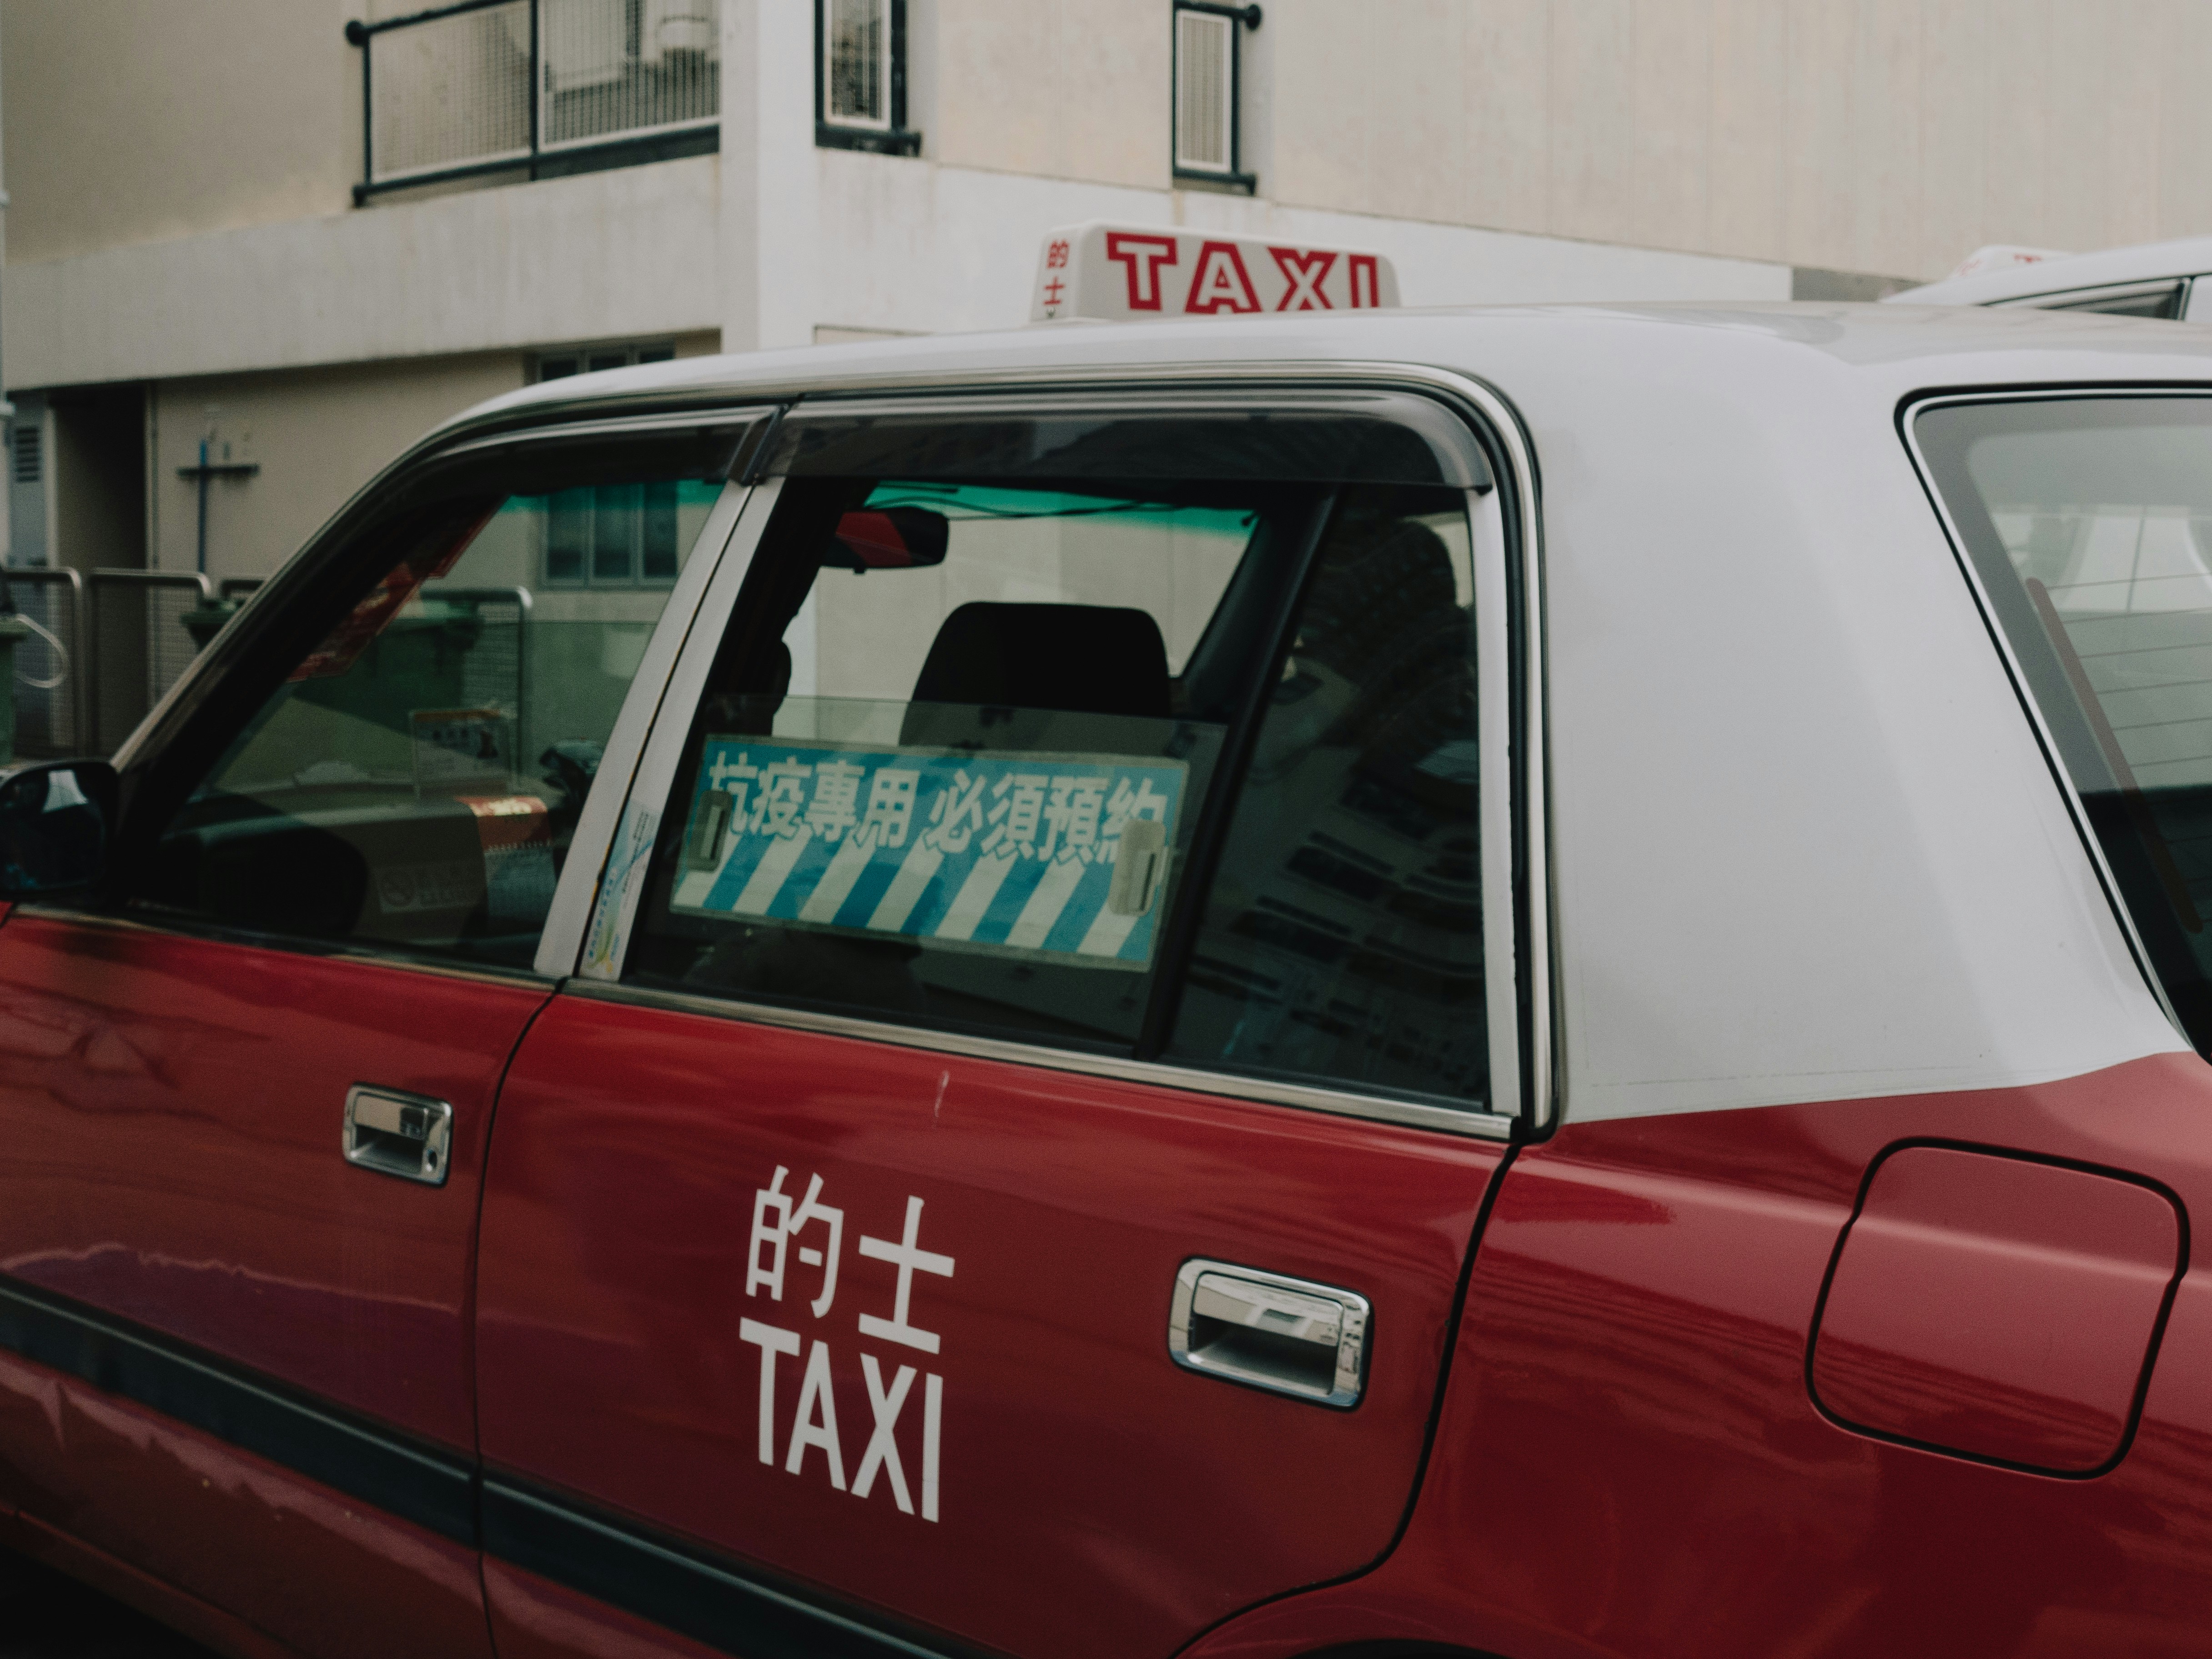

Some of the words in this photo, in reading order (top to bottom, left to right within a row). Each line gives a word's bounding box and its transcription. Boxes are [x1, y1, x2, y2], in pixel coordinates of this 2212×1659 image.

[1043, 238, 1069, 307] 的士
[1106, 232, 1380, 315] TAXI
[746, 1165, 955, 1355] 的士
[739, 1317, 943, 1523] TAXI
